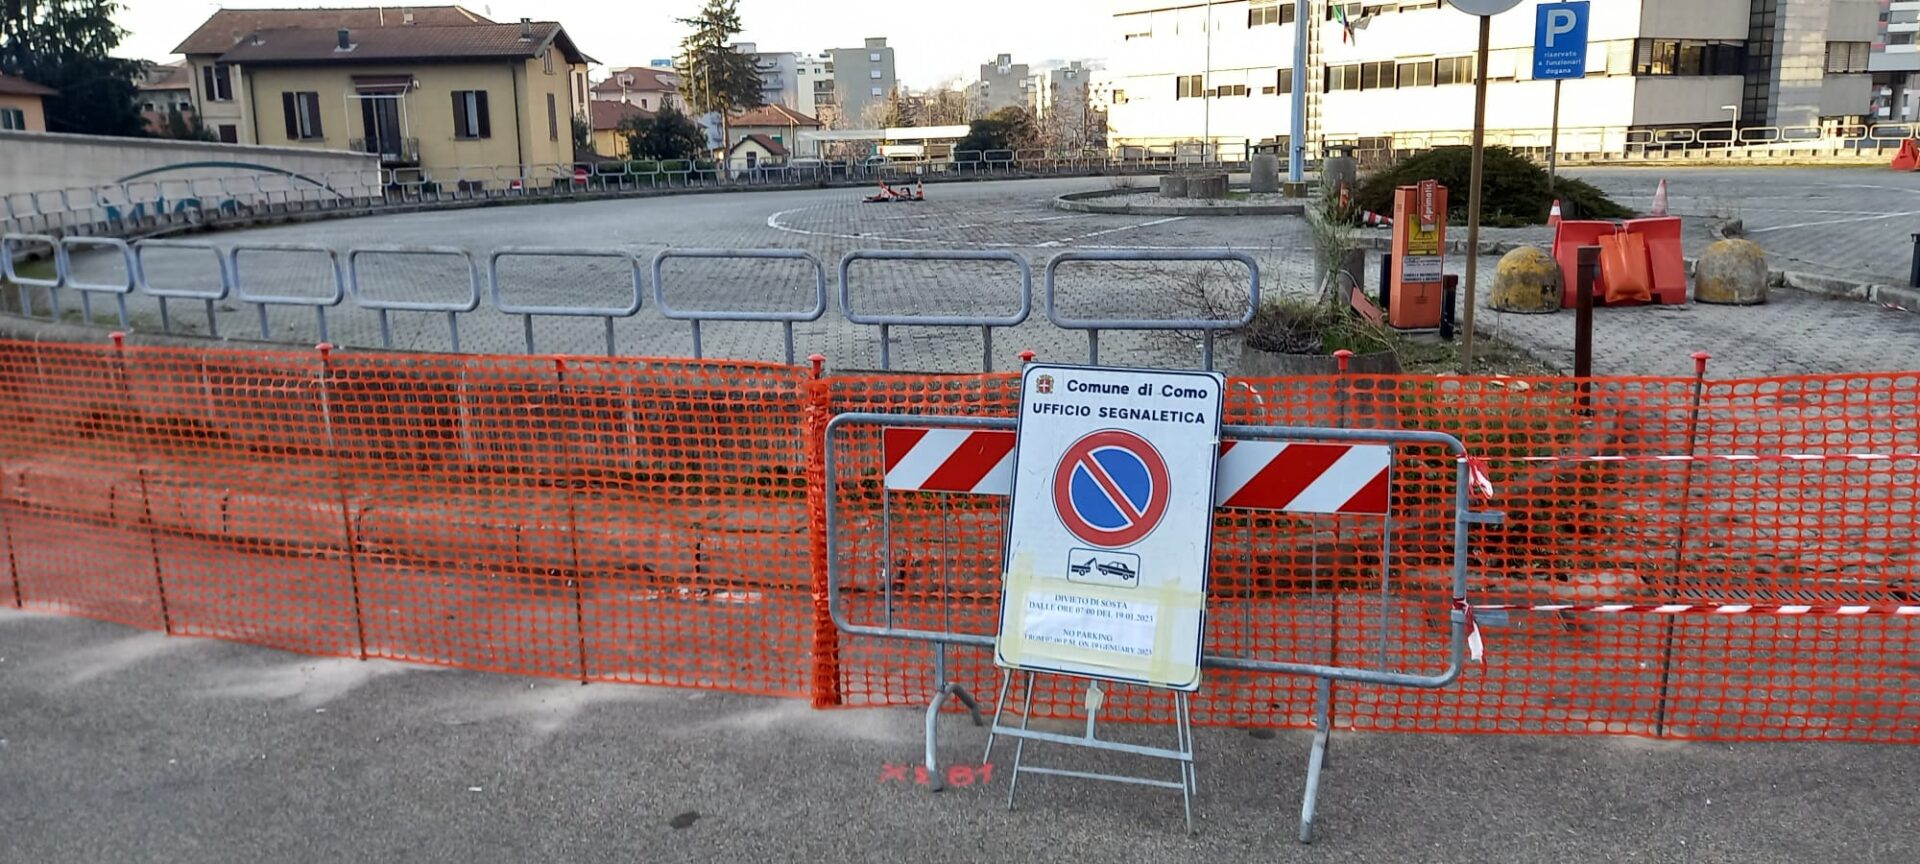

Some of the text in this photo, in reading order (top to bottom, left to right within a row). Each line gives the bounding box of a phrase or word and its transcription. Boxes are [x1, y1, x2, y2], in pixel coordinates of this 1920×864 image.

[1545, 9, 1577, 48] P
[1423, 183, 1434, 221] Aprimatic
[1066, 379, 1208, 399] Comune di Como
[1032, 402, 1206, 424] UFFICIO SEGNALETICA
[1029, 600, 1054, 611] DALLE
[1054, 594, 1128, 610] DIVIETO DI SOSTA
[1063, 628, 1113, 642] NO PARKING
